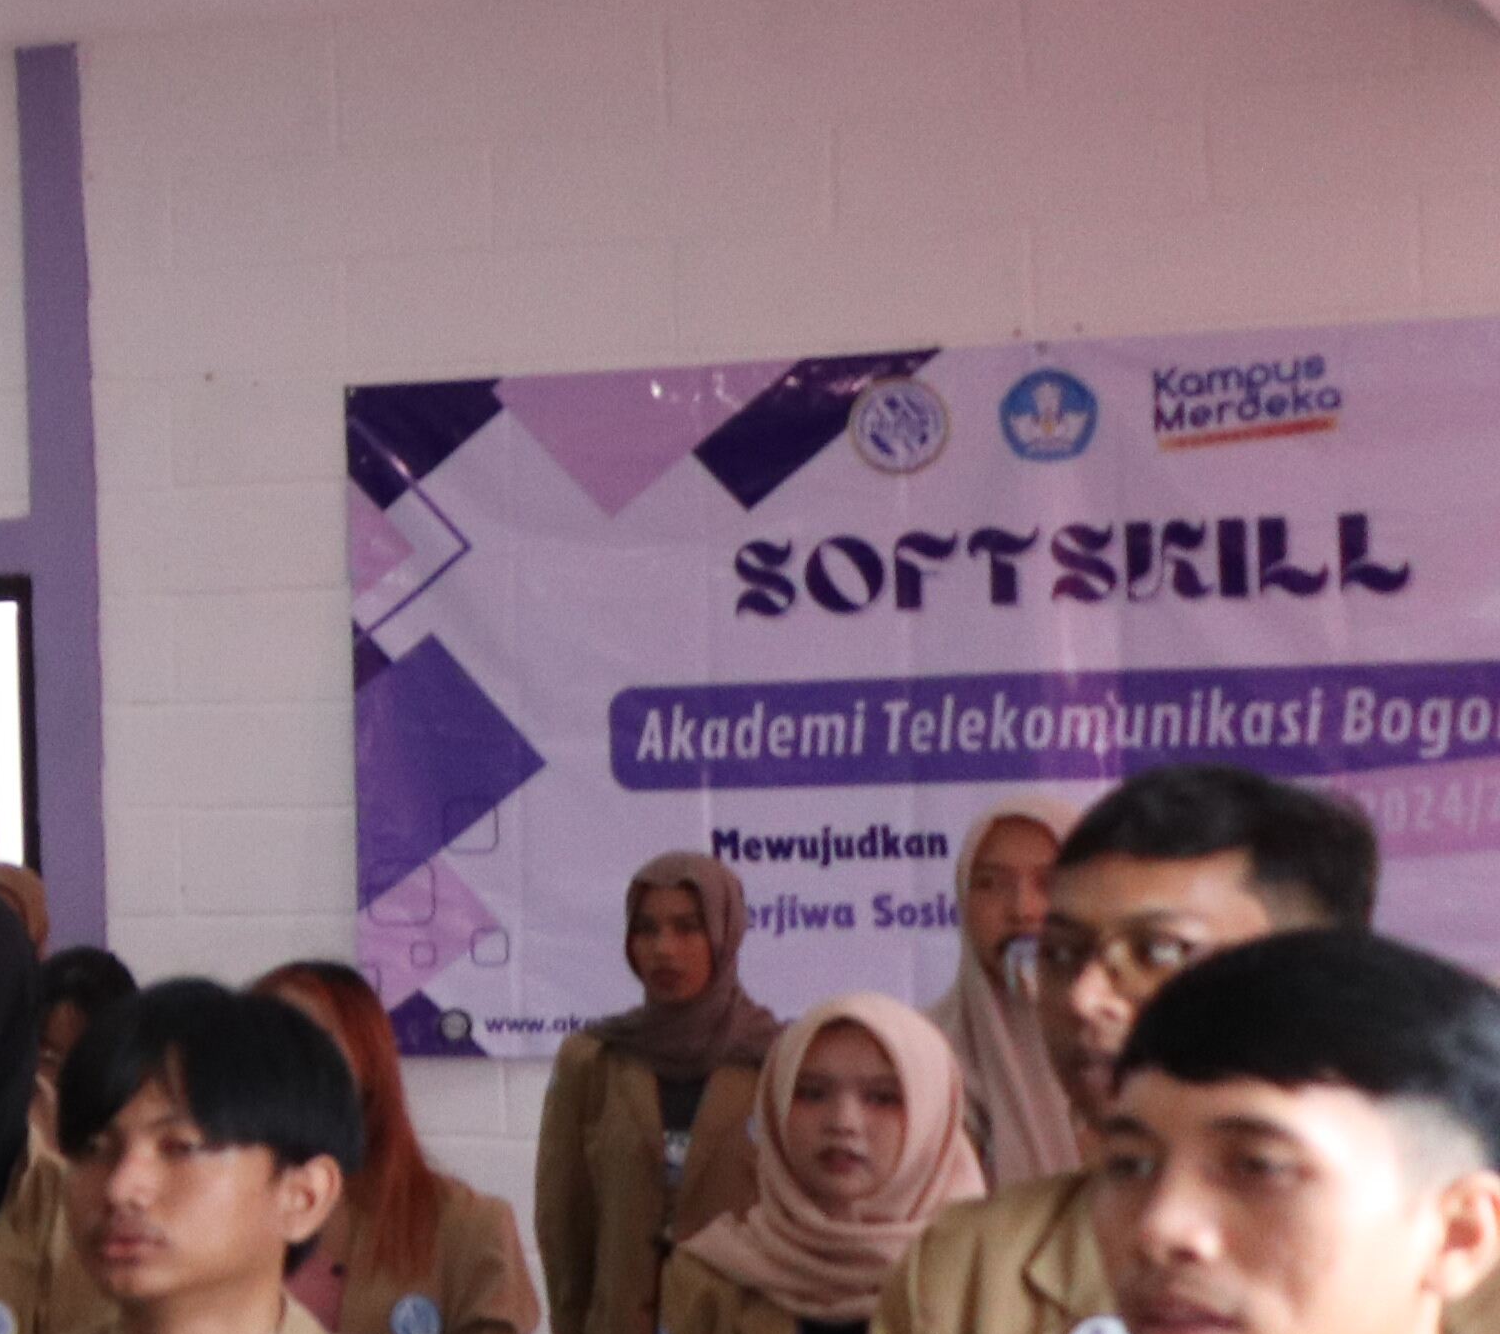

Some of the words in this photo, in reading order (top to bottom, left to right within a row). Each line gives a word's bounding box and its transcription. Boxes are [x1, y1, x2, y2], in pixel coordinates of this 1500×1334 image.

[1153, 353, 1326, 400] Kampus
[1153, 385, 1342, 433] Merdeka
[636, 701, 867, 762] Akademi
[882, 687, 1325, 756] Telekomunikasi
[1340, 685, 1500, 761] Bogo
[711, 823, 948, 869] Mewujudkan
